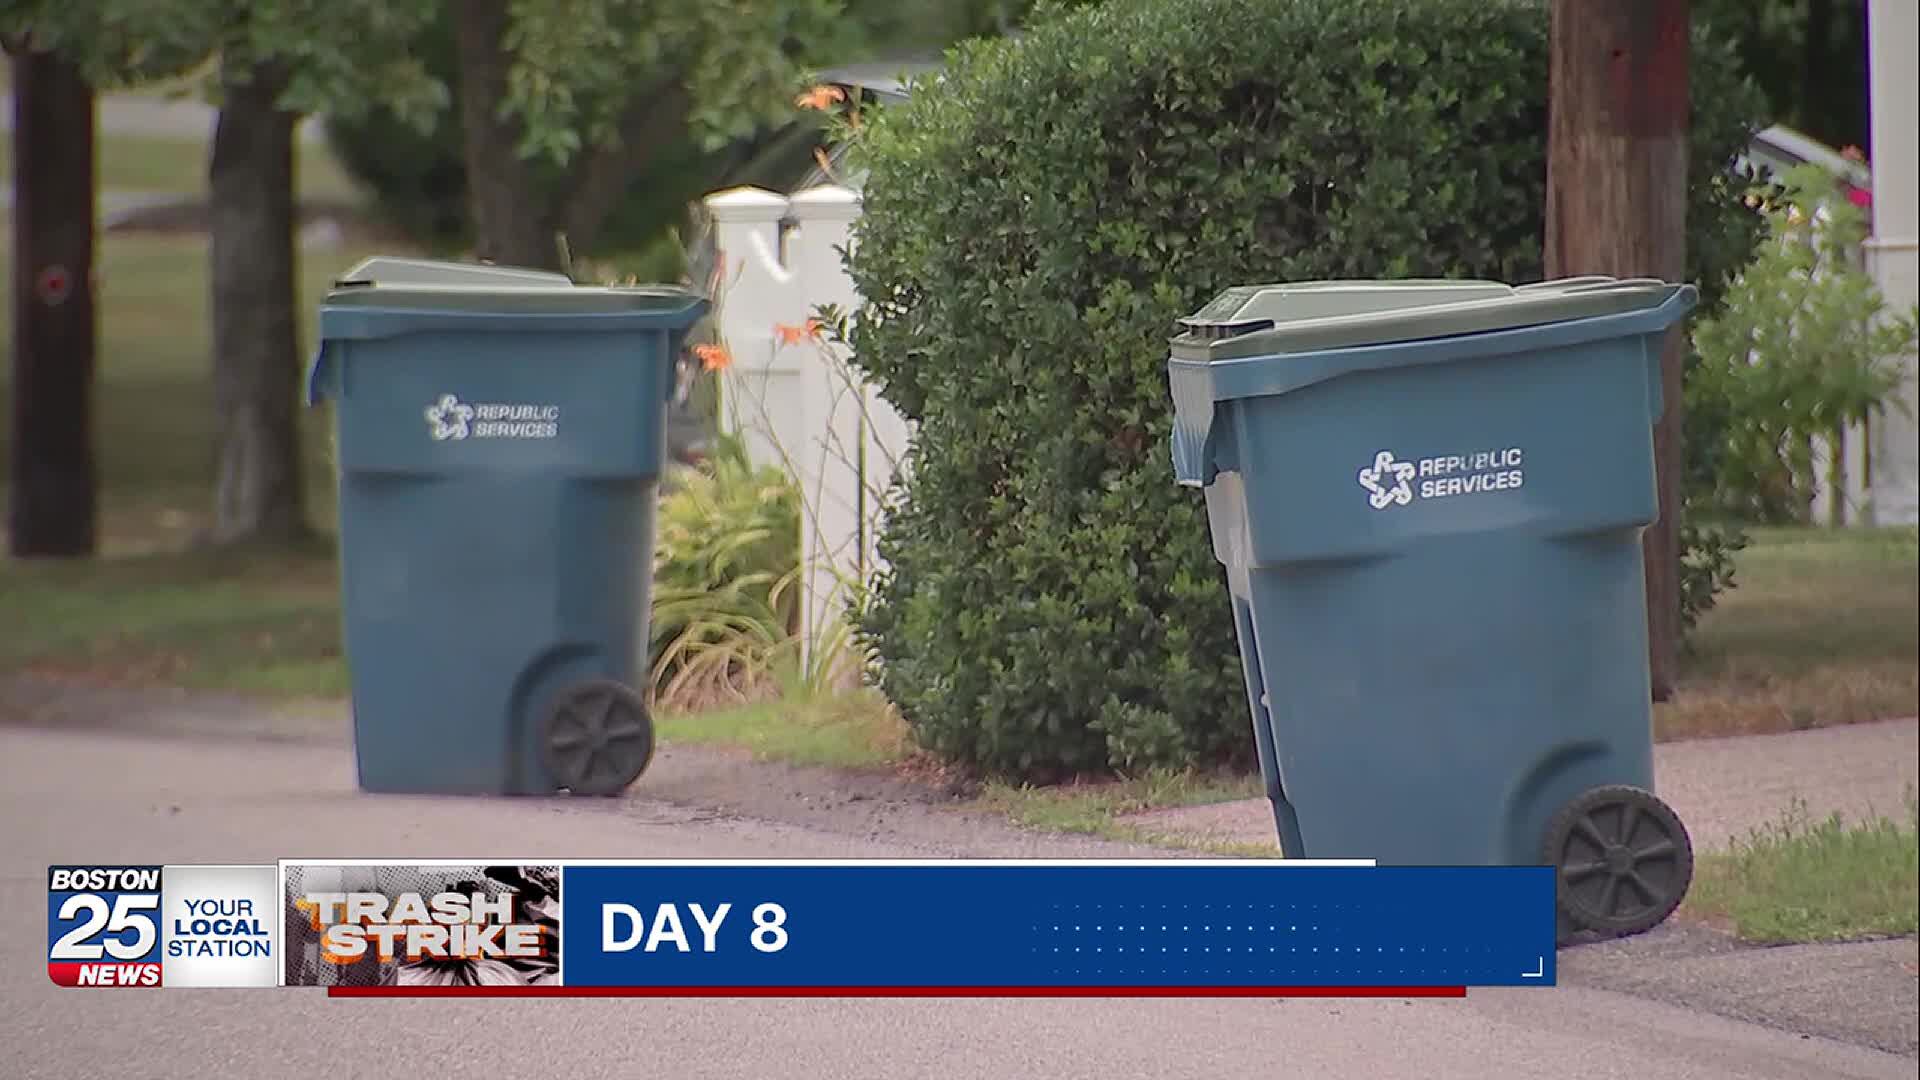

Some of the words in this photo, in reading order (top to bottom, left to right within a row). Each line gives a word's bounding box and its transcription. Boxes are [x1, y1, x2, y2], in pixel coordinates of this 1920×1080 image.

[476, 404, 559, 421] REPUBLIC
[475, 421, 559, 438] SERVICES
[1419, 448, 1522, 477] REPUBLIC
[1421, 469, 1524, 498] SERVICES
